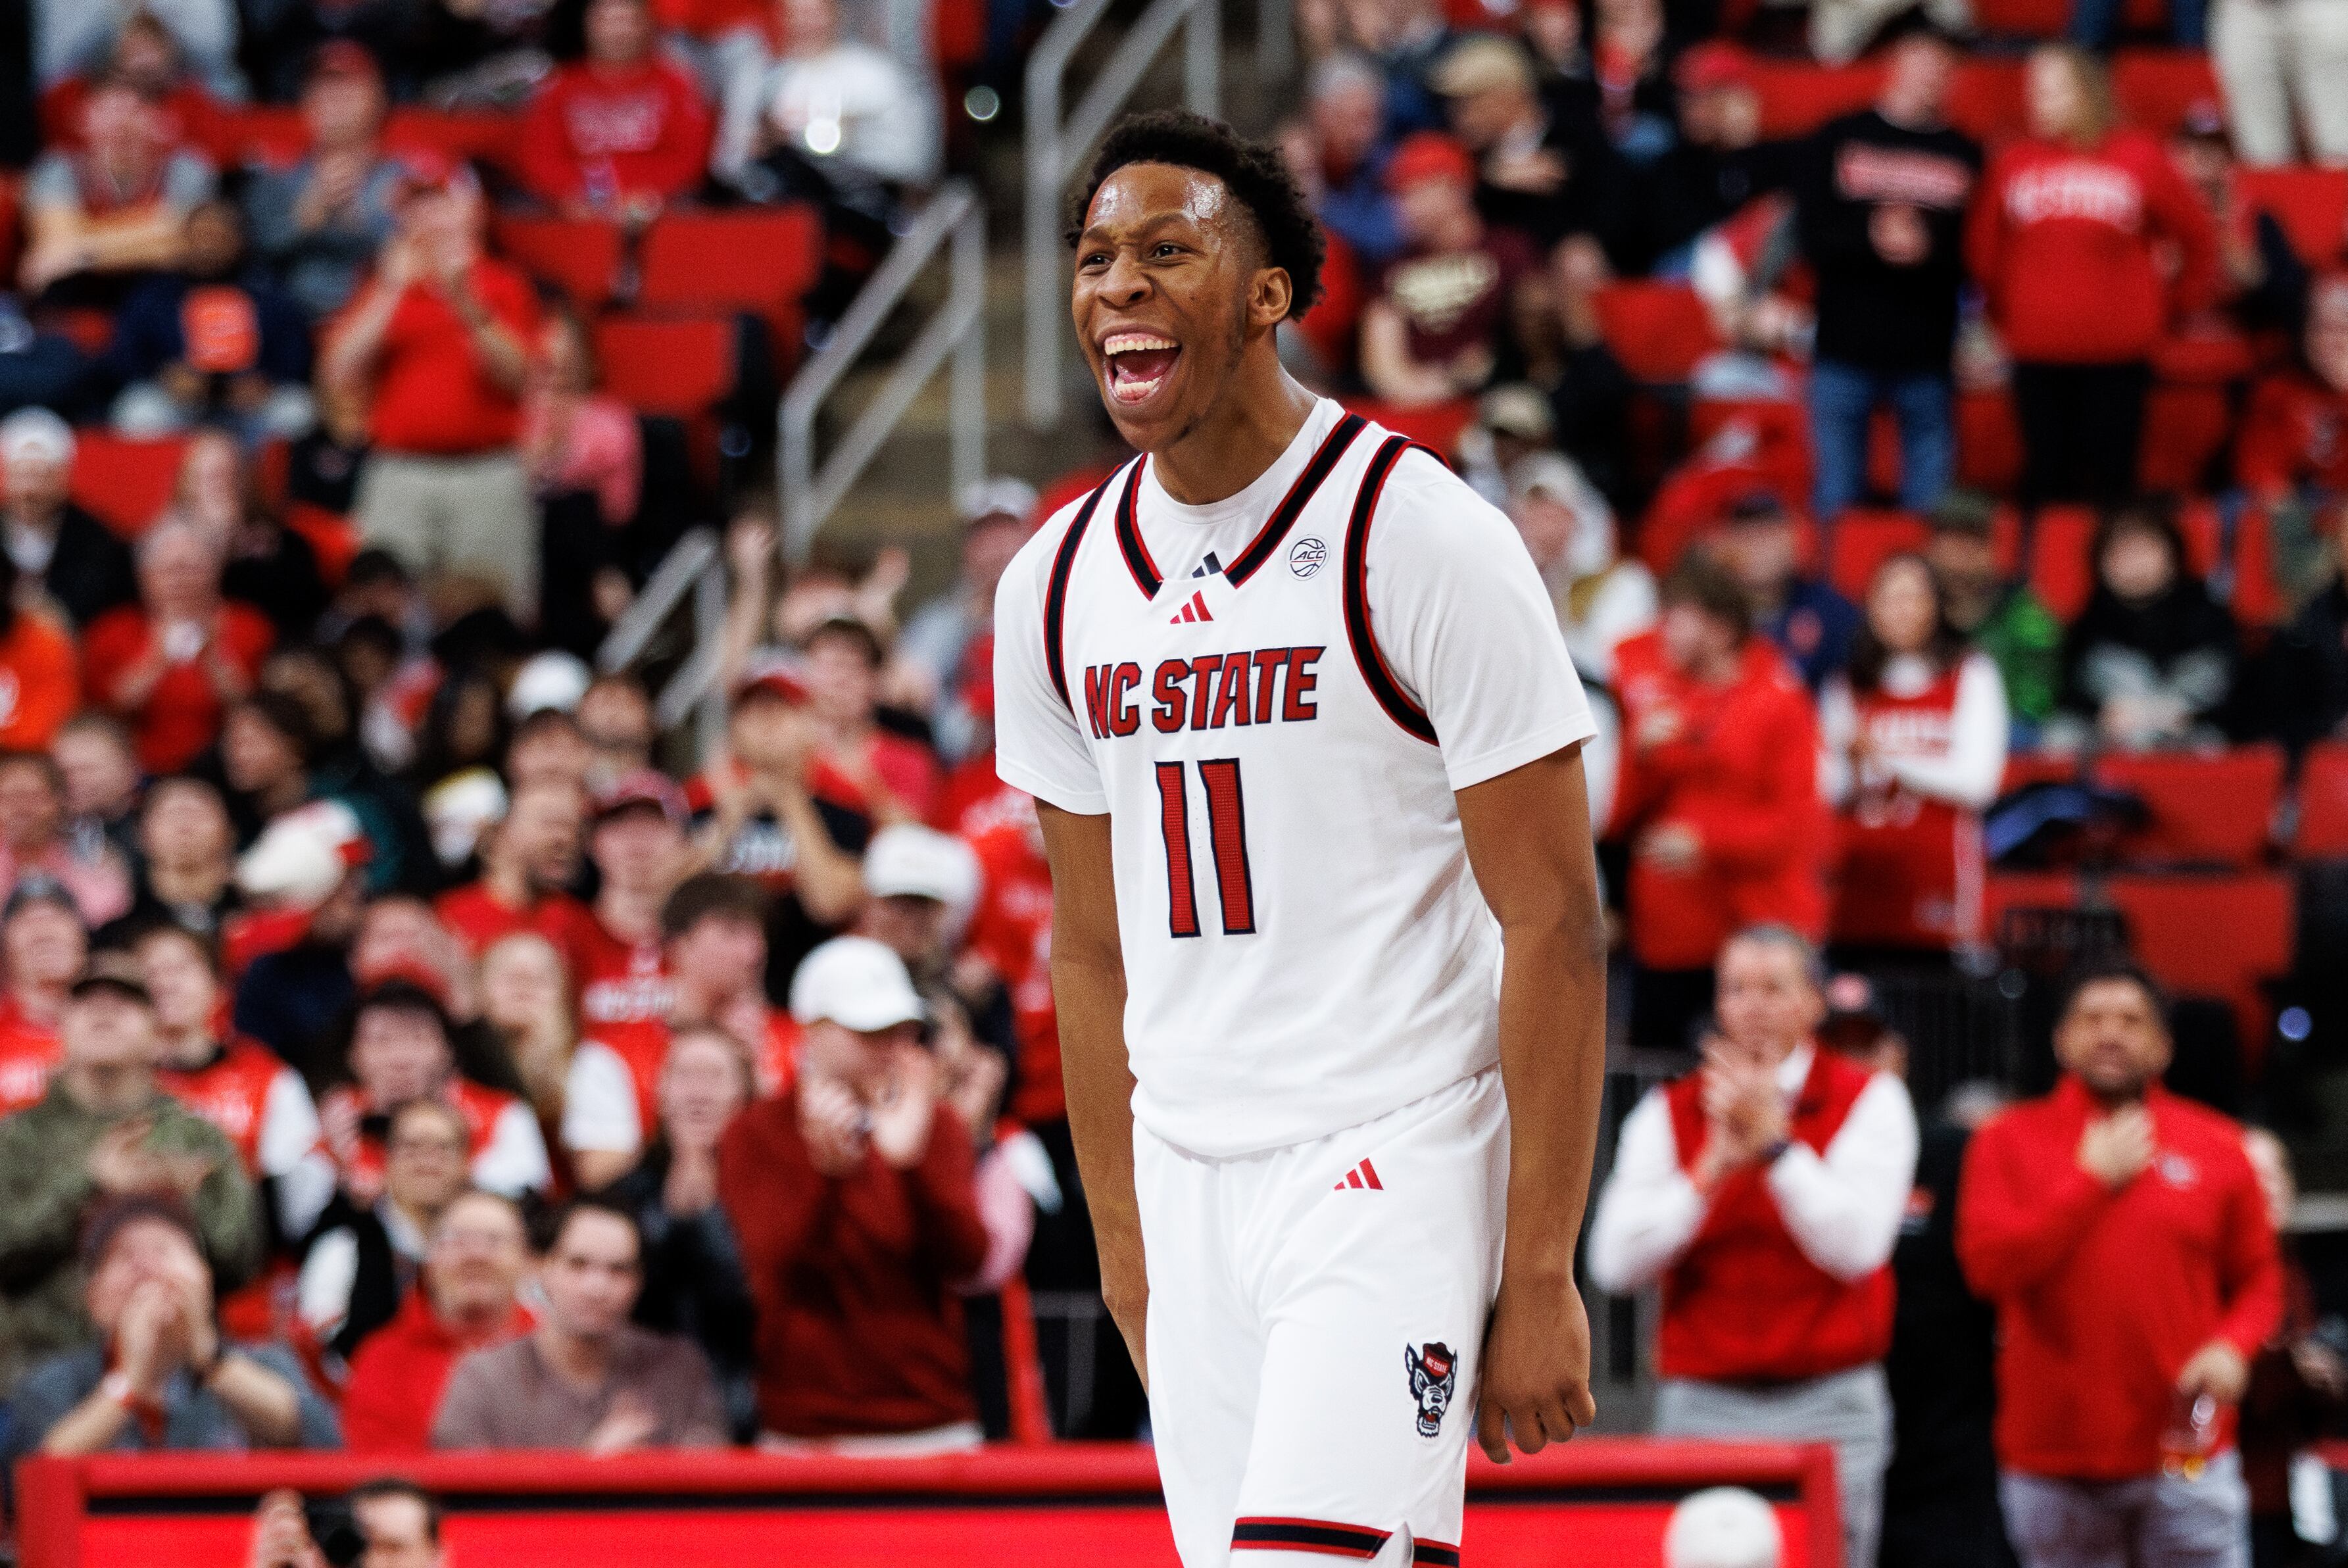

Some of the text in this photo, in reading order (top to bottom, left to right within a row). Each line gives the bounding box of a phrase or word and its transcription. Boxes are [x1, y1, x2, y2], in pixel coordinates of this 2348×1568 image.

[1294, 550, 1326, 560] ACC
[1085, 646, 1327, 739] NC STATE
[1154, 758, 1256, 939] 11
[1427, 1357, 1434, 1367] NC
